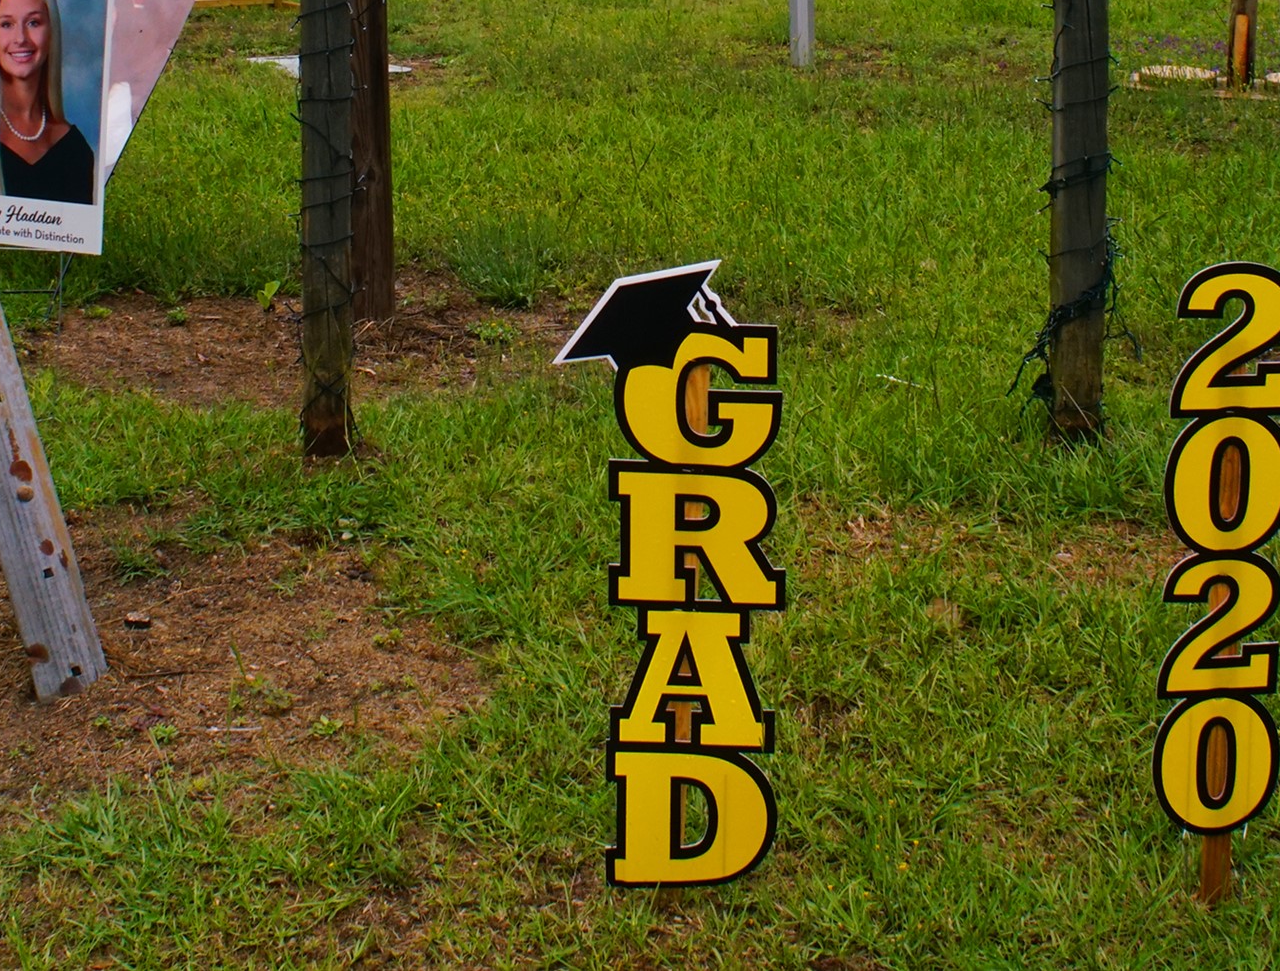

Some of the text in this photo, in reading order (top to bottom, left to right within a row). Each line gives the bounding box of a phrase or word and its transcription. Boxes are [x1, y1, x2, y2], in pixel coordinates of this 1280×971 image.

[5, 204, 63, 226] Haddon
[13, 227, 33, 239] with
[35, 230, 85, 245] Distinction
[607, 324, 786, 887] GRAD
